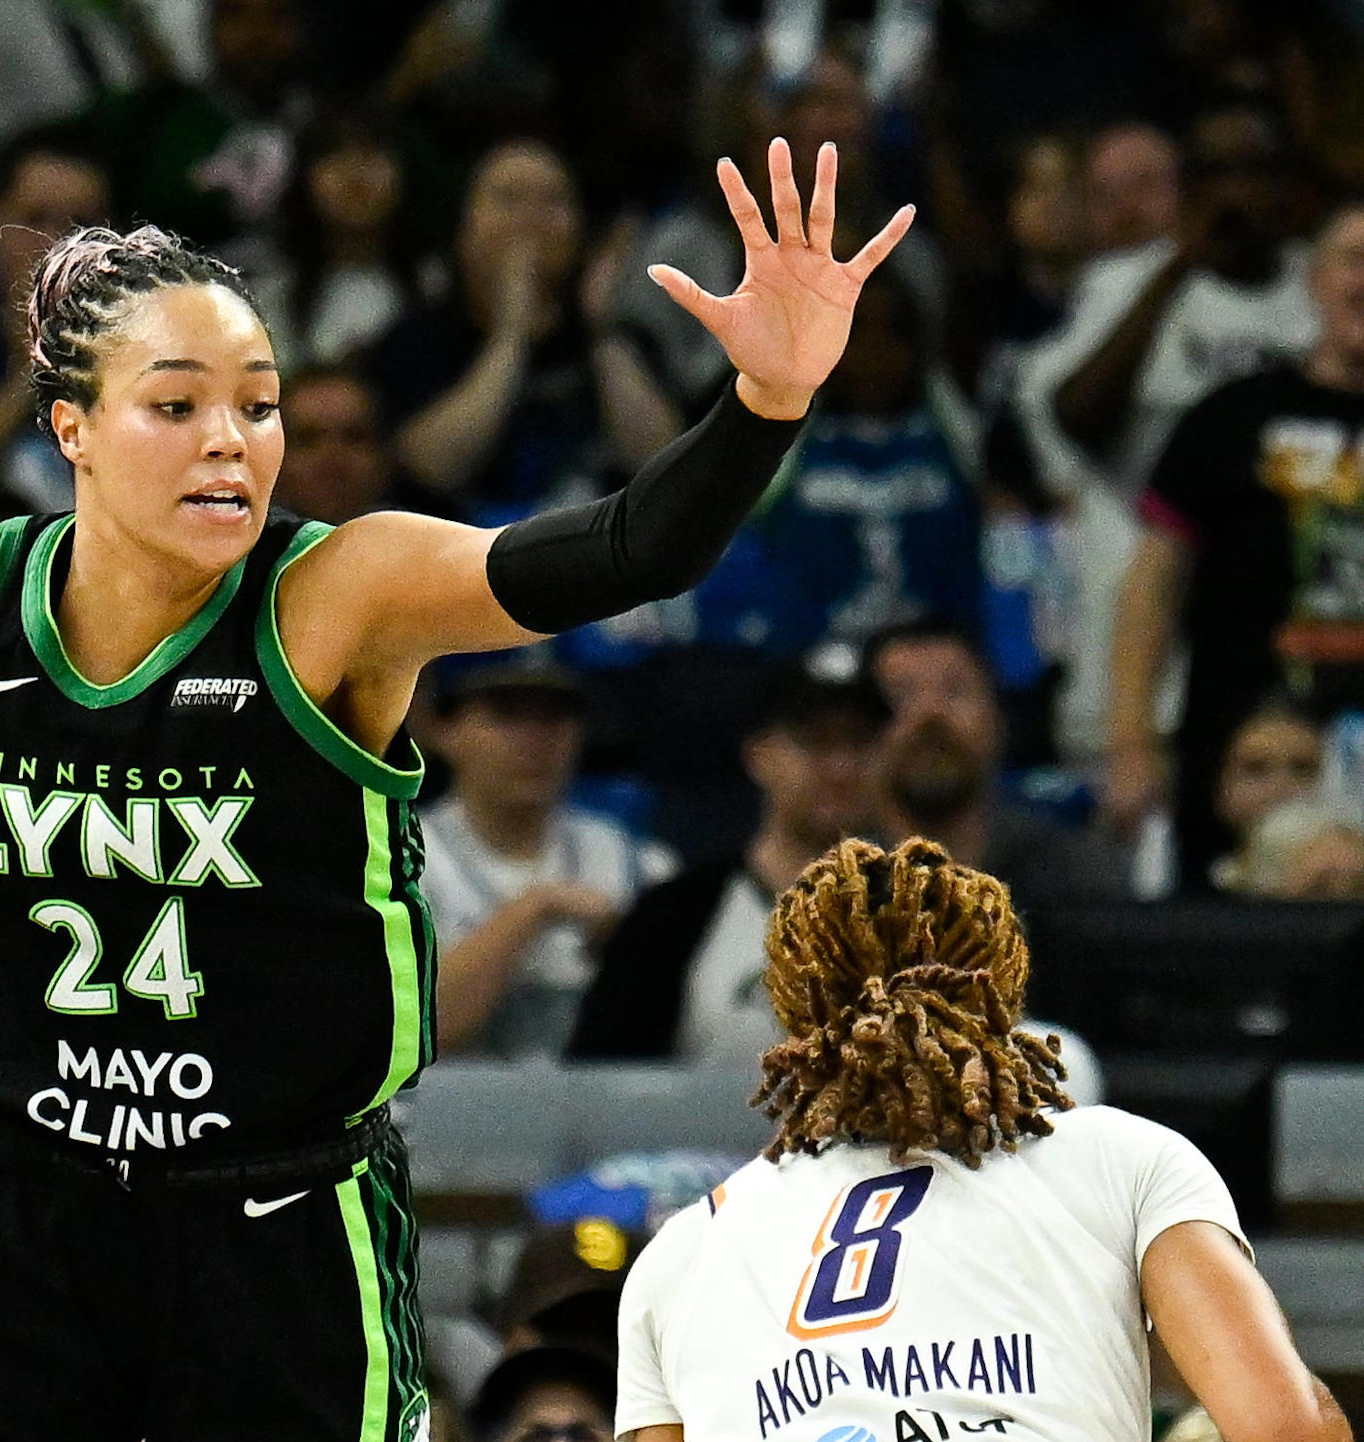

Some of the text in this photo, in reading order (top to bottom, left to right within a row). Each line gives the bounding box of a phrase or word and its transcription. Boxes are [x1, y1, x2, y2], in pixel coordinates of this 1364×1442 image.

[173, 677, 258, 697] FEDERATED
[28, 896, 205, 1020] 24
[57, 1039, 214, 1099] MAYO
[785, 1165, 934, 1341] 8
[754, 1332, 1036, 1440] AKOA MAKANI
